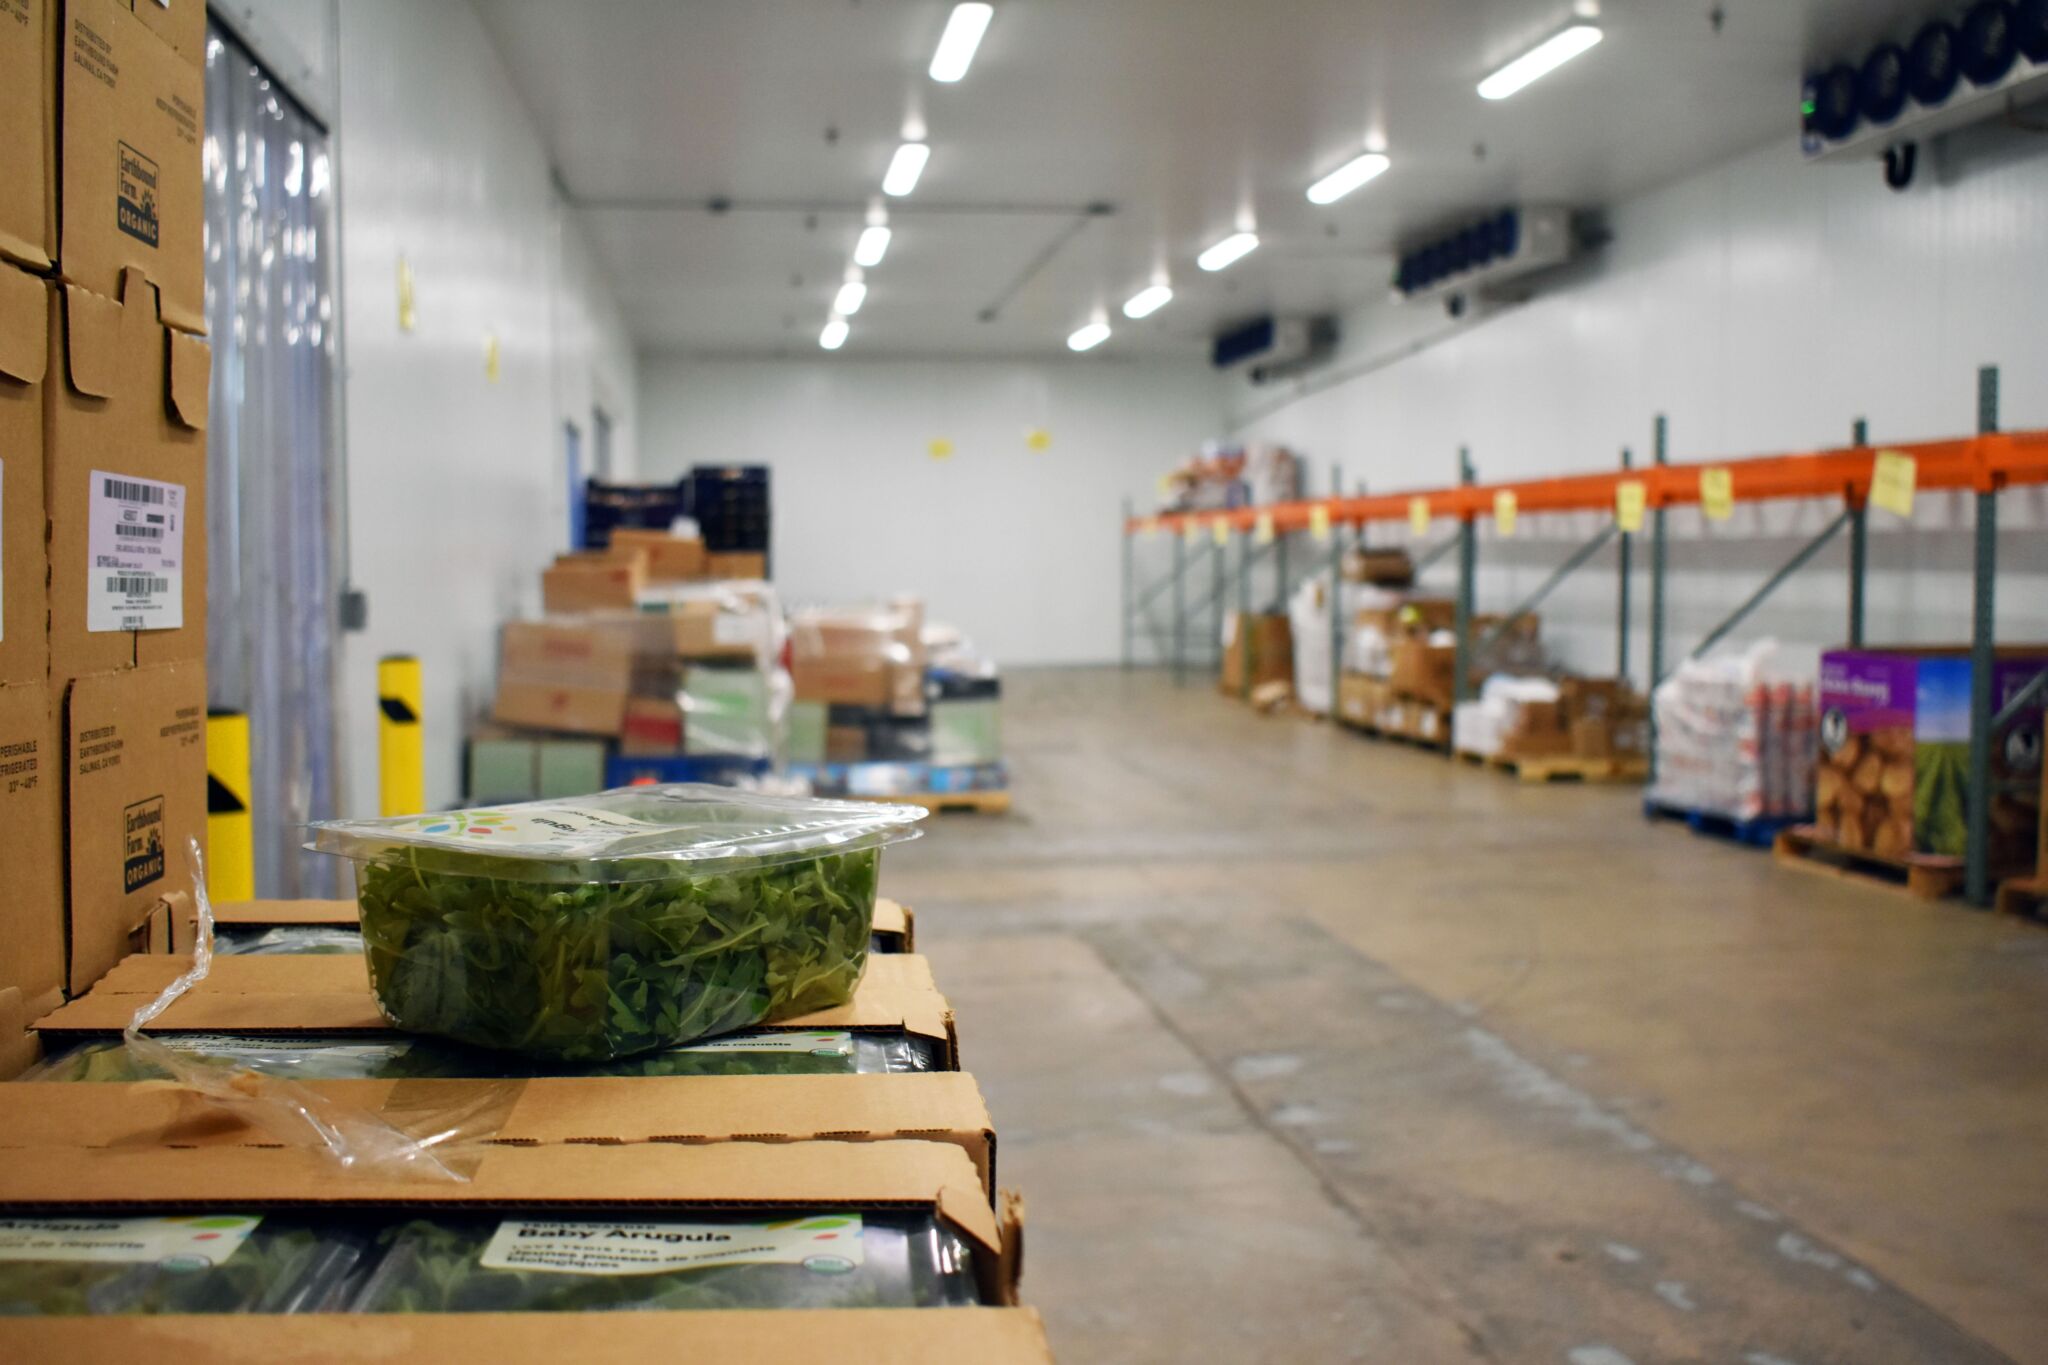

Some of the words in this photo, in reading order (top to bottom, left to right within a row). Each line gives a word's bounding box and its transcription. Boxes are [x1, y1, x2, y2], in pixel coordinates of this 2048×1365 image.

[120, 207, 157, 240] ORGANIC
[127, 856, 162, 885] ORGANIC
[518, 1227, 597, 1240] Baby
[605, 1228, 732, 1244] Arugula
[506, 1253, 621, 1269] biologiques
[511, 1249, 578, 1260] Jeunes
[584, 1253, 660, 1263] pousses
